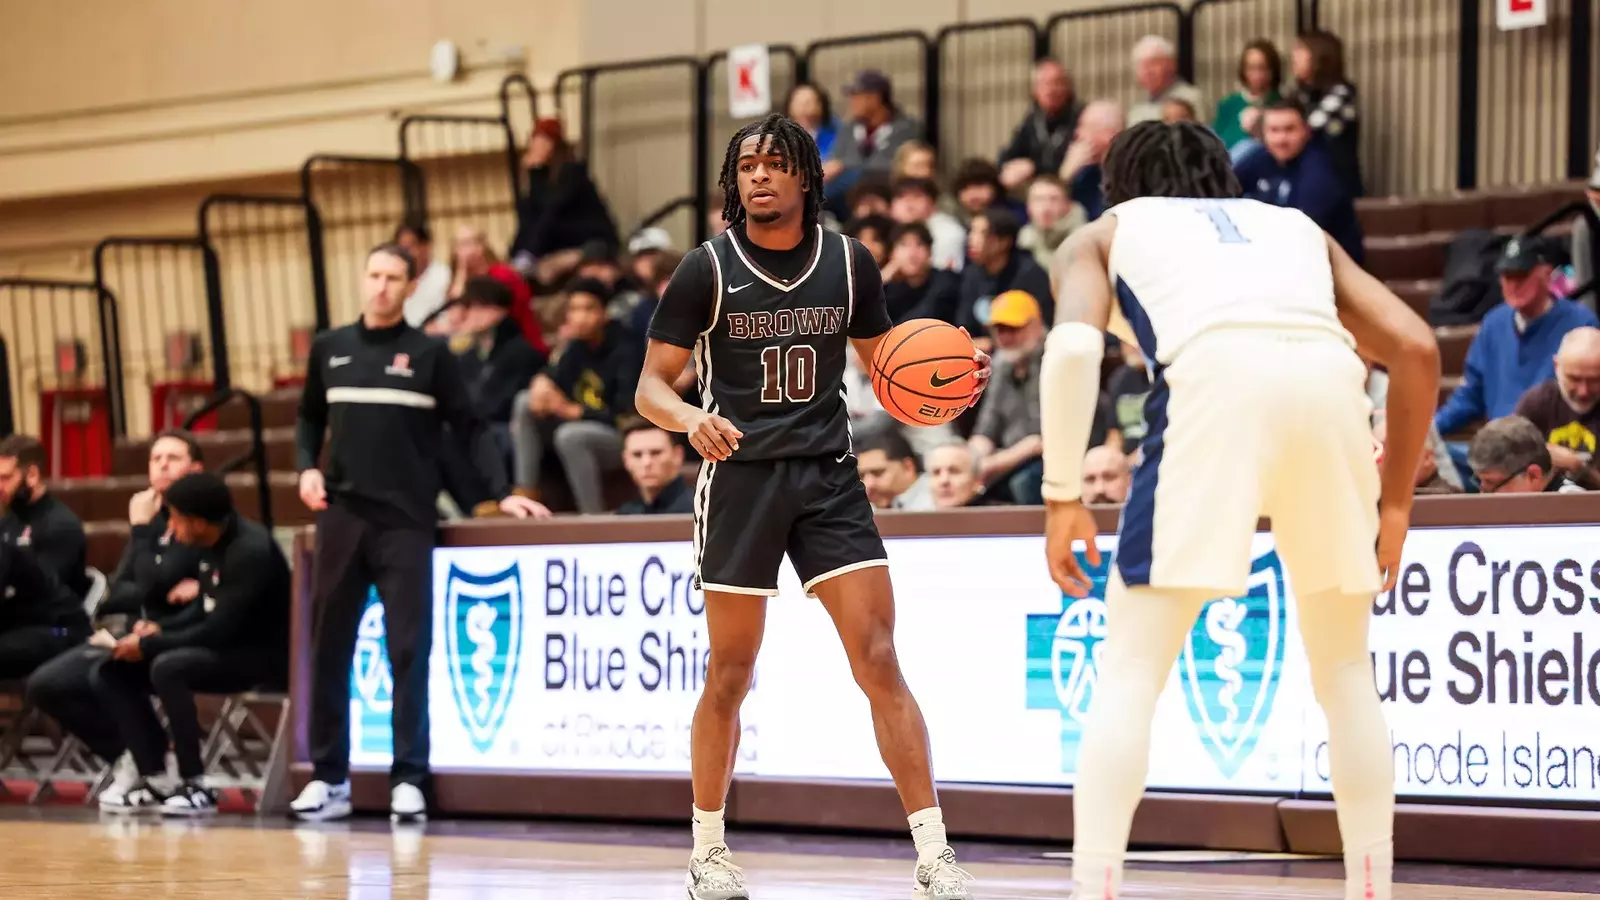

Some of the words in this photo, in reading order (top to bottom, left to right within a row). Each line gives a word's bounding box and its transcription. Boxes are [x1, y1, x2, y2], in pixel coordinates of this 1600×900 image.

[727, 306, 844, 339] BROWN
[760, 344, 816, 403] 10
[546, 557, 627, 616] Blue
[640, 555, 705, 616] Cro
[545, 632, 626, 691] Blue
[1371, 649, 1431, 704] ue
[1391, 729, 1488, 787] hode
[1503, 731, 1600, 789] Islan
